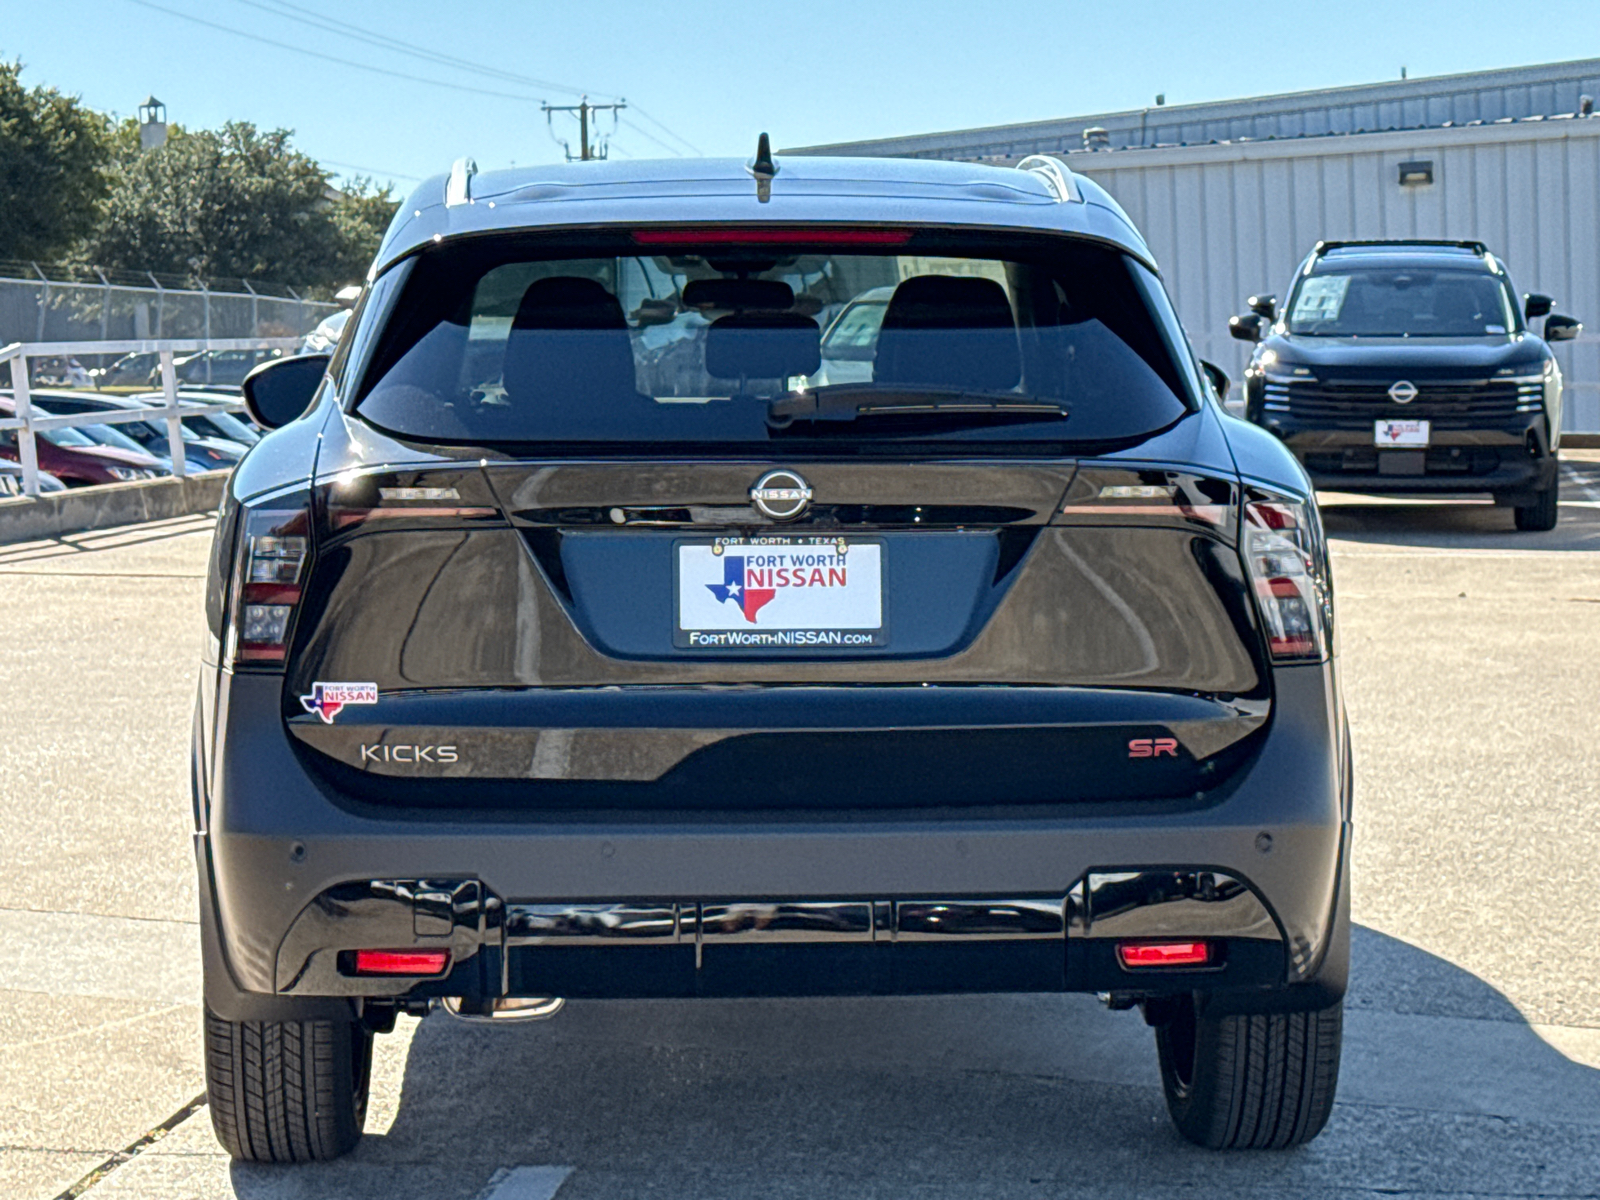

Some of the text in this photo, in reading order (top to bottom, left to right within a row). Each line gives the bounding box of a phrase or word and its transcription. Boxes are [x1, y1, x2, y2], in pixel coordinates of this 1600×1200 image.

[751, 488, 812, 500] NISSAN
[715, 537, 846, 545] FORT WORTH TEXAS
[746, 554, 847, 568] FORT WORTH
[747, 567, 847, 588] NISSAN
[324, 691, 376, 701] NISSAN
[360, 744, 459, 763] KICKS
[1128, 737, 1179, 758] SR
